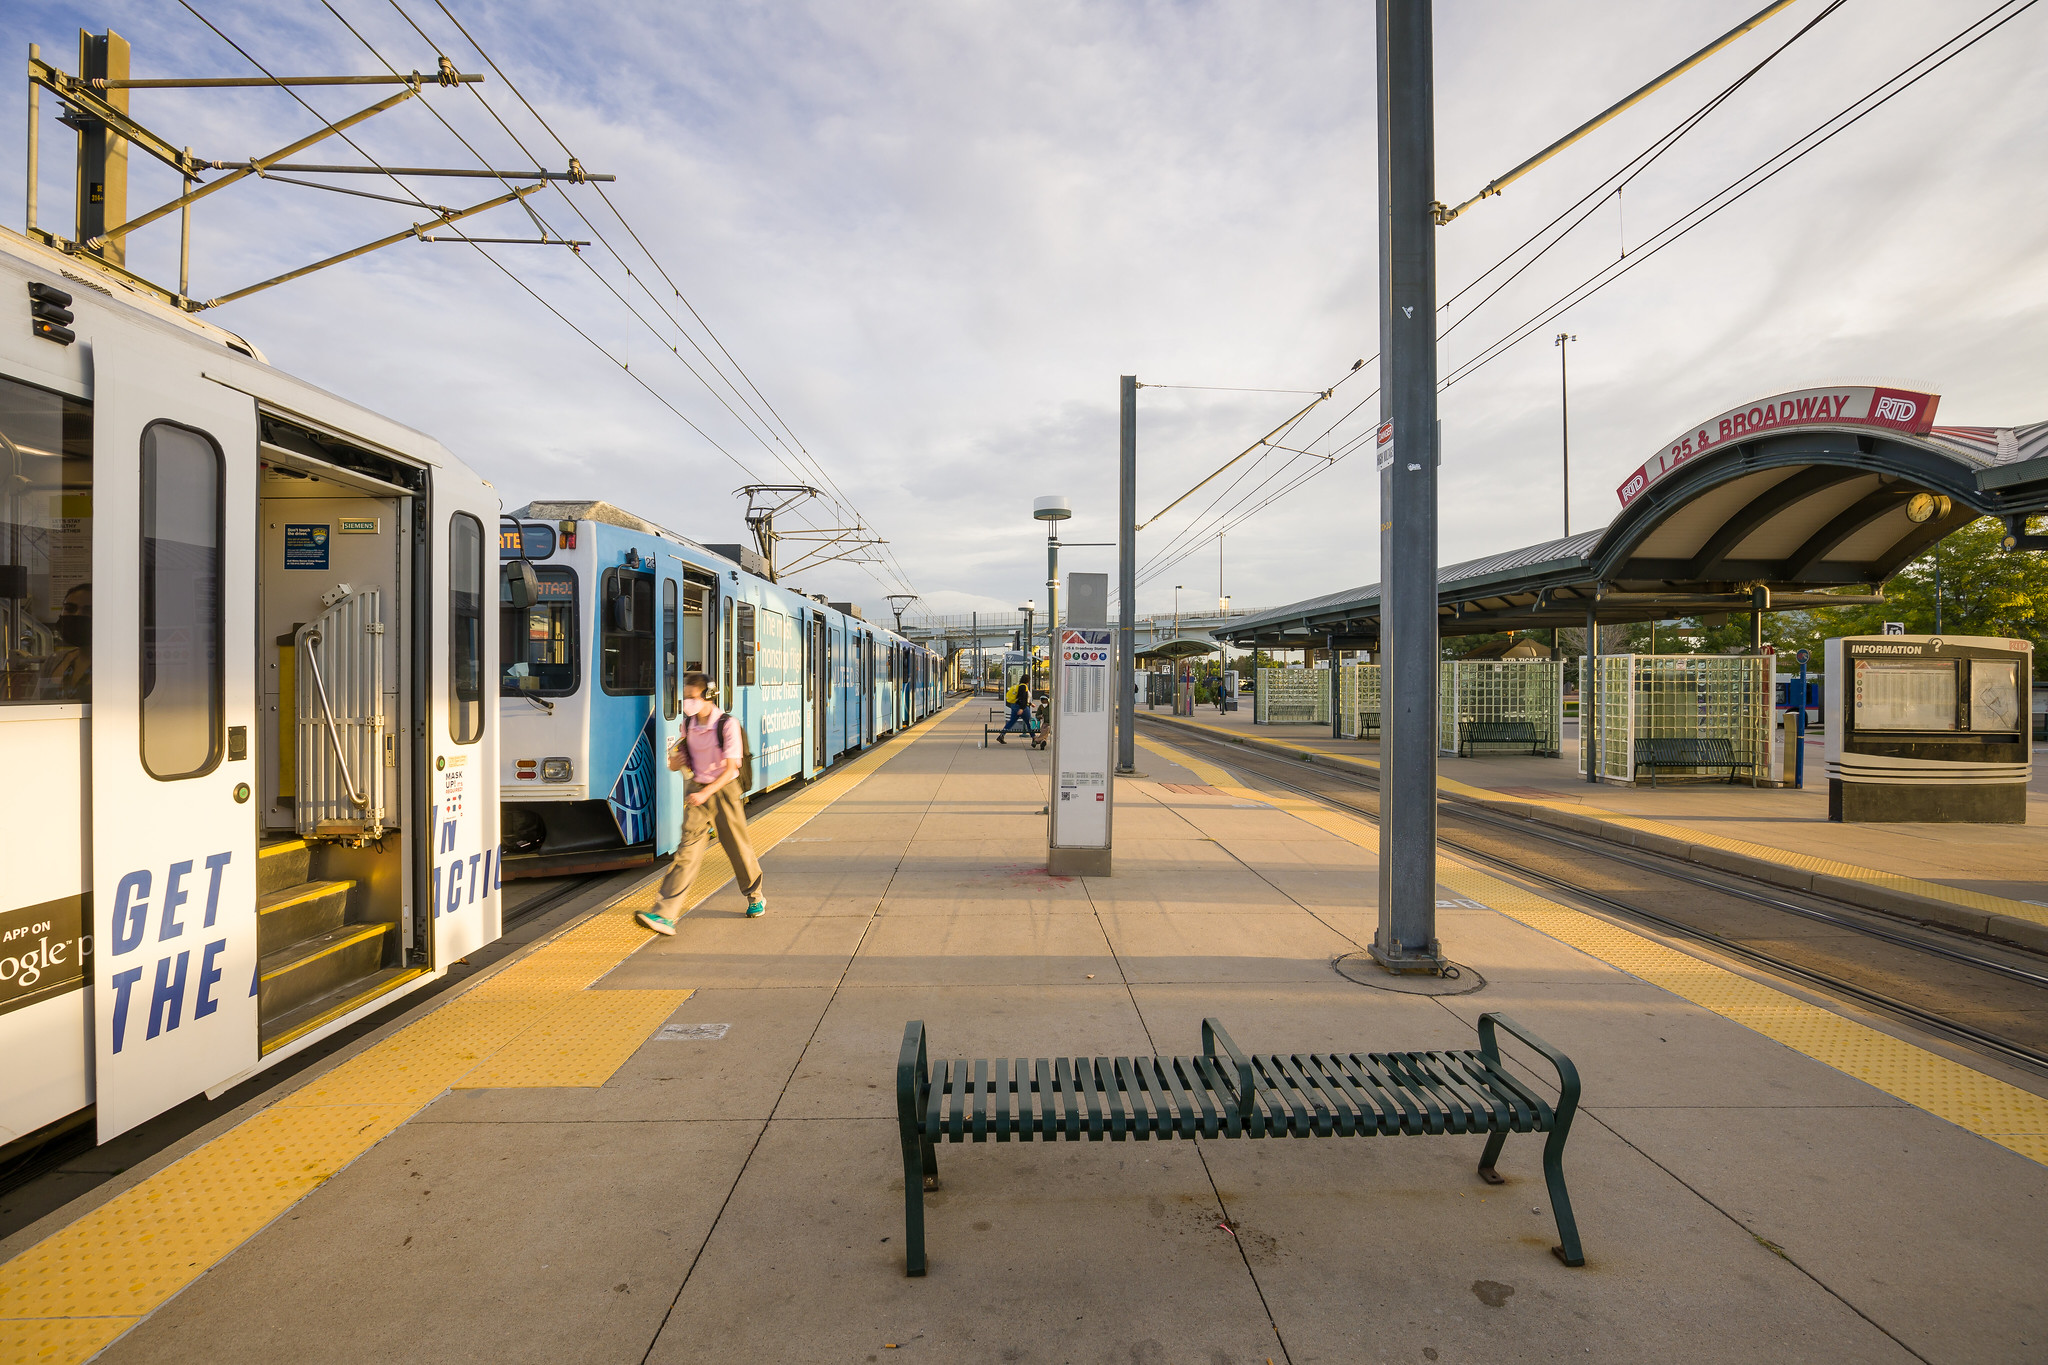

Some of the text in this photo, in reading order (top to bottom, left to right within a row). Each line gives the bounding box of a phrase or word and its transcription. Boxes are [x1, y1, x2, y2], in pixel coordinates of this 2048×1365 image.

[1874, 396, 1917, 422] RTD
[1671, 438, 1693, 466] 25
[1697, 429, 1710, 451] &
[1719, 395, 1850, 443] BROADWAY
[1621, 474, 1644, 502] RTD
[761, 611, 793, 640] The mst
[1851, 644, 1922, 655] INFORMATION
[2009, 640, 2029, 650] RTD
[761, 647, 789, 673] nonstp
[761, 676, 799, 702] to the most
[761, 706, 801, 735] destinations
[761, 742, 779, 768] from
[445, 771, 463, 780] MASK
[445, 780, 456, 789] UP!
[111, 850, 233, 957] GET
[2, 920, 52, 943] APP ON
[111, 937, 227, 1056] THE
